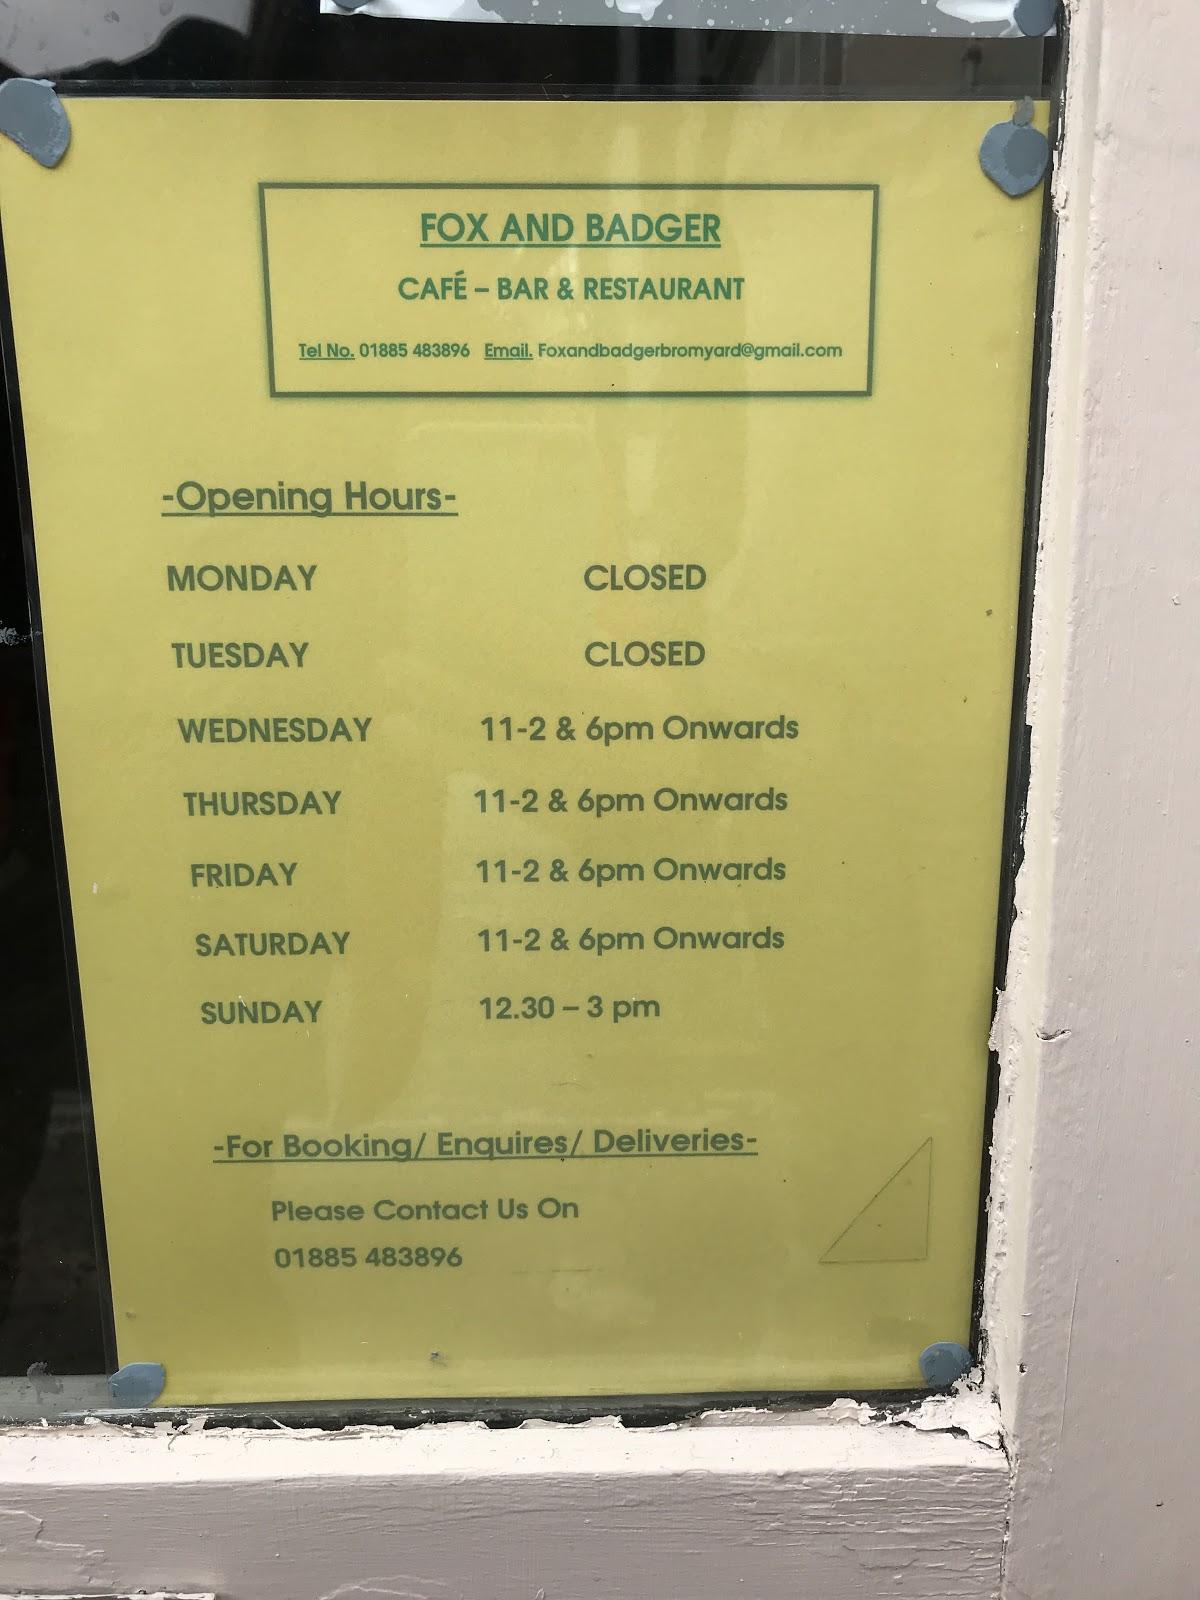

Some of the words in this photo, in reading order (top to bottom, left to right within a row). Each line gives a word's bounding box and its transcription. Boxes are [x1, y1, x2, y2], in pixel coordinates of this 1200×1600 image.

[420, 212, 489, 242] FOX
[501, 212, 574, 242] AND
[586, 212, 721, 242] BADGER
[397, 269, 468, 301] CAFÉ
[496, 276, 550, 301] BAR
[556, 276, 575, 302] &
[582, 275, 746, 301] RESTAURANT
[299, 343, 321, 358] Tel
[326, 343, 355, 358] No.
[358, 342, 409, 359] 01885
[412, 342, 471, 359] 483896
[484, 343, 533, 358] Email.
[537, 342, 843, 362] Foxandbadgerbromyard@gmail.com
[161, 480, 333, 517] -Opening
[345, 480, 458, 512] Hours-
[166, 564, 318, 592] MONDAY
[583, 563, 707, 592] CLOSED
[170, 641, 310, 669] TUESDAY
[584, 640, 706, 668] CLOSED
[177, 716, 373, 744] WEDNESDAY
[480, 715, 546, 742] 11-2
[555, 715, 576, 742] &
[584, 715, 654, 747] 6pm
[662, 714, 799, 741] Onwards
[182, 790, 342, 817] THURSDAY
[473, 788, 539, 814] 11-2
[547, 788, 569, 813] &
[577, 788, 645, 819] 6pm
[653, 786, 788, 812] Onwards
[190, 862, 298, 889] FRIDAY
[476, 858, 540, 884] 11-2
[549, 858, 569, 883] &
[578, 857, 645, 888] 6pm
[653, 856, 787, 887] Onwards
[195, 931, 351, 957] SATURDAY
[477, 927, 541, 953] 11-2
[550, 927, 570, 952] &
[578, 927, 645, 957] 6pm
[653, 925, 785, 950] Onwards
[200, 999, 323, 1026] SUNDAY
[479, 995, 555, 1020] 12.30
[586, 994, 604, 1019] 3
[612, 995, 661, 1024] pm
[213, 1134, 274, 1160] -For
[283, 1131, 426, 1162] Booking/
[438, 1130, 582, 1160] Enquires/
[594, 1128, 758, 1156] Deliveries-
[271, 1200, 365, 1222] Please
[373, 1199, 489, 1221] Contact
[497, 1198, 529, 1220] Us
[537, 1197, 579, 1219] On
[274, 1247, 358, 1269] 01885
[364, 1246, 463, 1268] 483896
